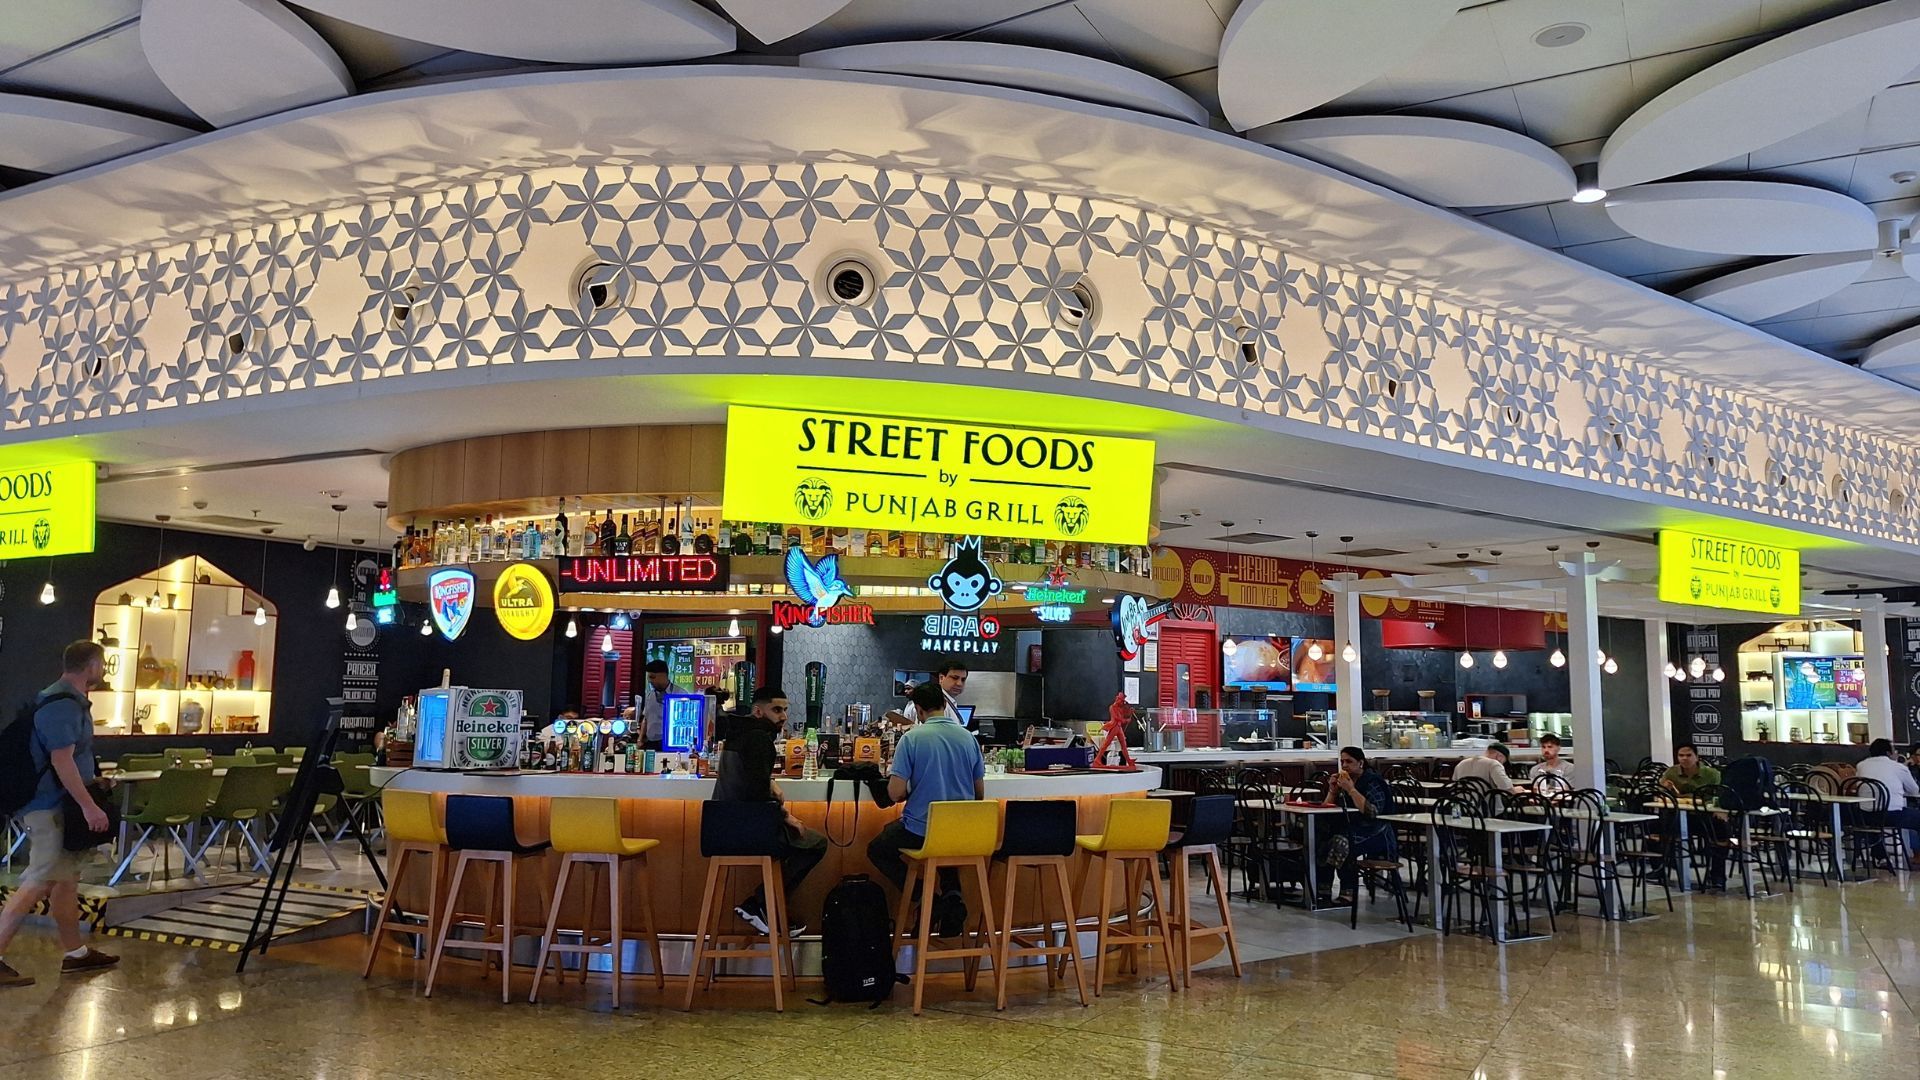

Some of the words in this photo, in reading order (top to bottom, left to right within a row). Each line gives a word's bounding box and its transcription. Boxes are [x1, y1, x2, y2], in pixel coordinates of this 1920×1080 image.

[798, 417, 949, 462] STREET
[963, 431, 1095, 472] FOODS
[939, 469, 958, 487] by
[845, 491, 957, 523] PUNJAB
[965, 500, 1044, 525] GRILL
[1690, 537, 1737, 564] STREET
[1740, 545, 1781, 571] FOODS
[1238, 554, 1278, 584] KEBAB
[1027, 586, 1087, 604] Heineken
[1240, 584, 1261, 605] NON
[1262, 587, 1278, 607] VEG
[1705, 583, 1741, 602] PUNJAB
[1742, 587, 1767, 602] GRILL
[501, 598, 535, 607] ULTRA
[774, 602, 874, 628] KINGFISHER
[924, 615, 980, 637] BIRA
[983, 621, 996, 634] 91
[714, 644, 740, 656] BEER
[922, 638, 999, 654] MAKEPLAY
[347, 662, 377, 676] PANEER
[676, 664, 693, 674] 2+1
[700, 657, 715, 665] Pint
[699, 666, 715, 675] 2+1
[456, 720, 519, 733] Heineken
[471, 738, 502, 750] SILVER
